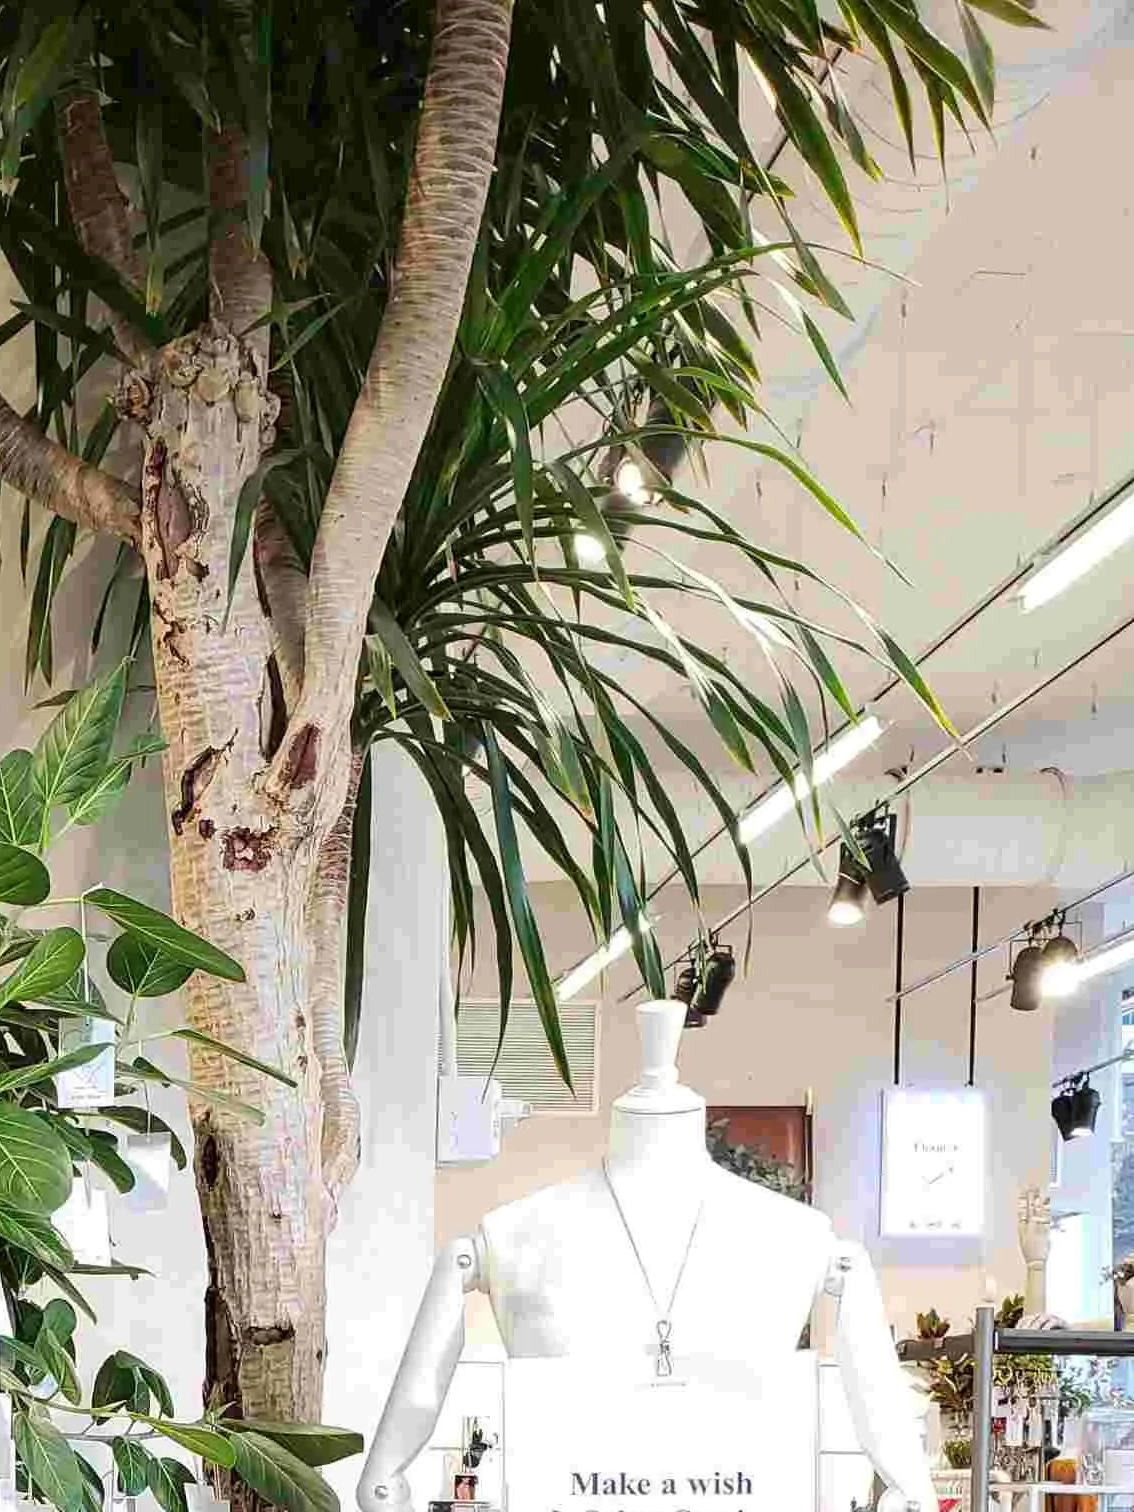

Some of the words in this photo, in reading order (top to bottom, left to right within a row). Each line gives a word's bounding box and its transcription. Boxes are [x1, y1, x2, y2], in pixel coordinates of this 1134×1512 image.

[570, 1472, 651, 1496] Make
[661, 1478, 677, 1496] a
[687, 1472, 753, 1496] wish
